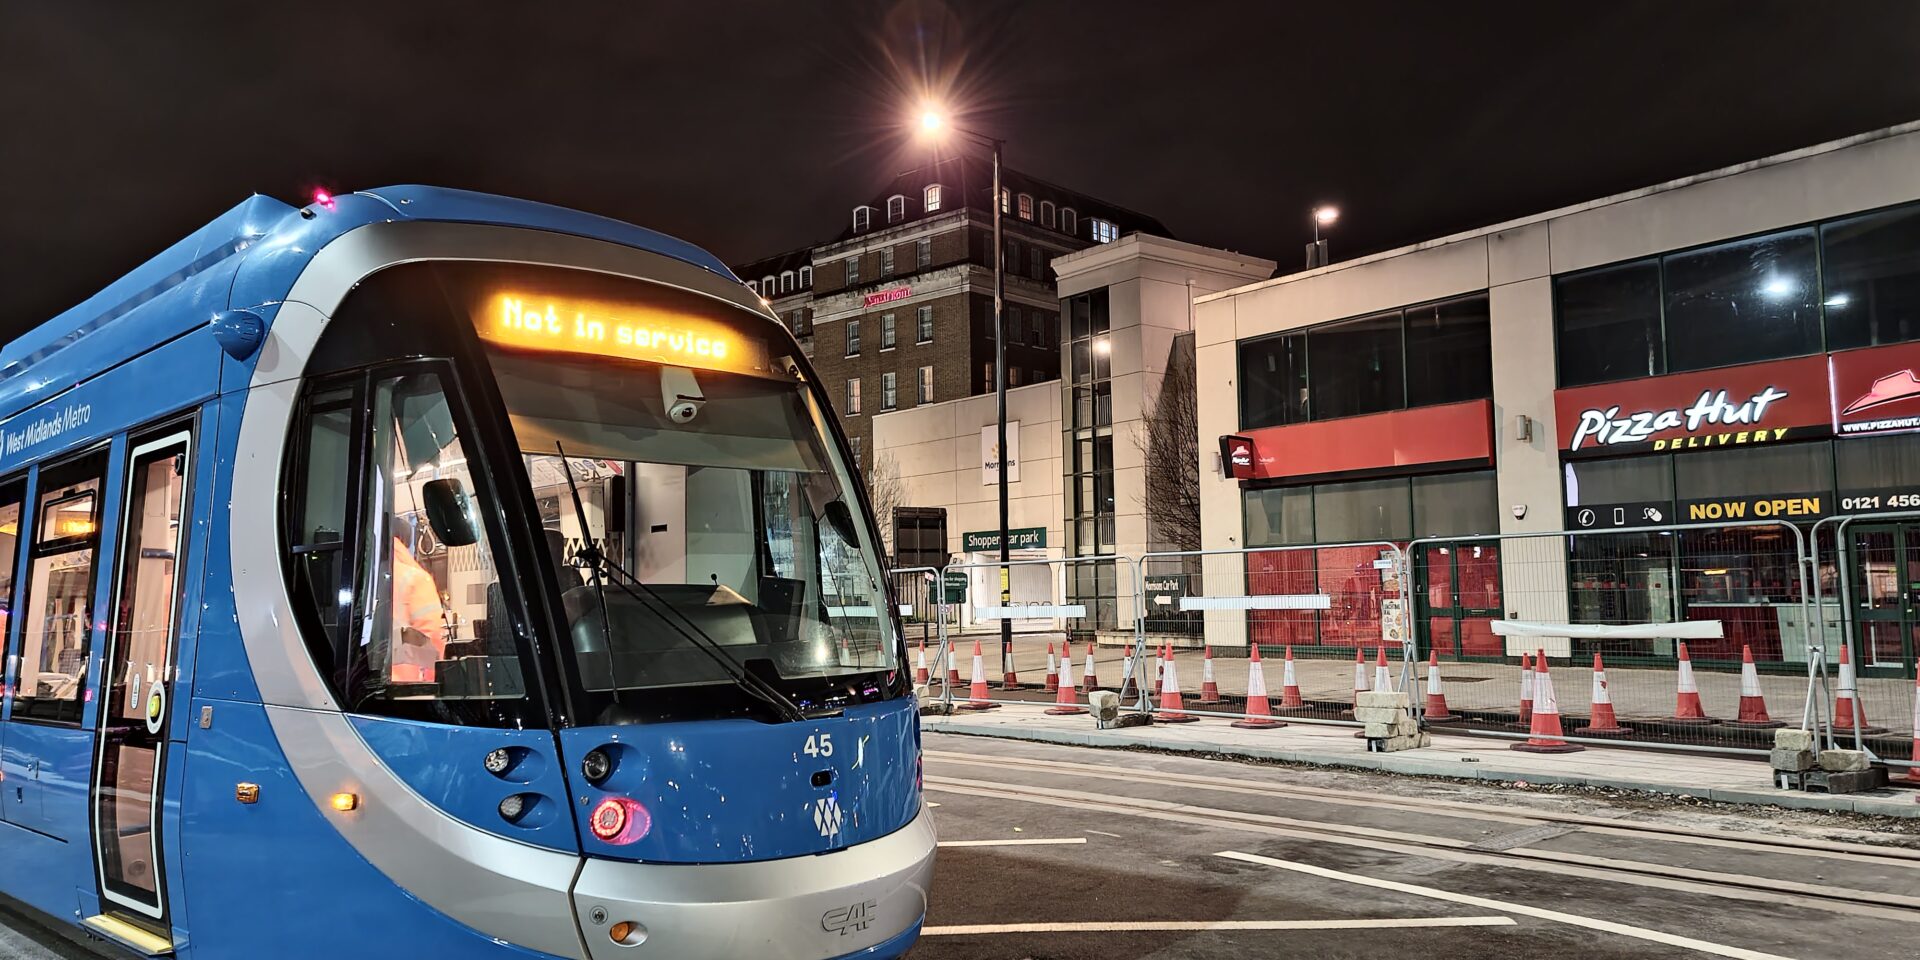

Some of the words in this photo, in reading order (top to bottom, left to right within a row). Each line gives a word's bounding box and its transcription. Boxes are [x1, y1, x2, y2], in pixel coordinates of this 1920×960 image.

[502, 298, 562, 334] Not
[575, 314, 605, 341] in
[617, 325, 728, 359] service
[6, 430, 25, 456] West
[24, 411, 62, 448] Midlands
[62, 404, 91, 433] Metro
[1571, 405, 1682, 451] Pizza
[1685, 387, 1788, 431] Hut
[1842, 417, 1920, 432] WWW.PIZZAHUT.
[1653, 428, 1788, 451] DELIVERY
[1690, 502, 1746, 520] NOW
[1754, 498, 1820, 517] OPEN
[1841, 496, 1880, 510] 0121
[1886, 494, 1920, 507] 456
[968, 534, 1001, 549] Shopper
[1020, 530, 1039, 547] park
[804, 734, 833, 758] 45
[821, 899, 878, 937] CAF
